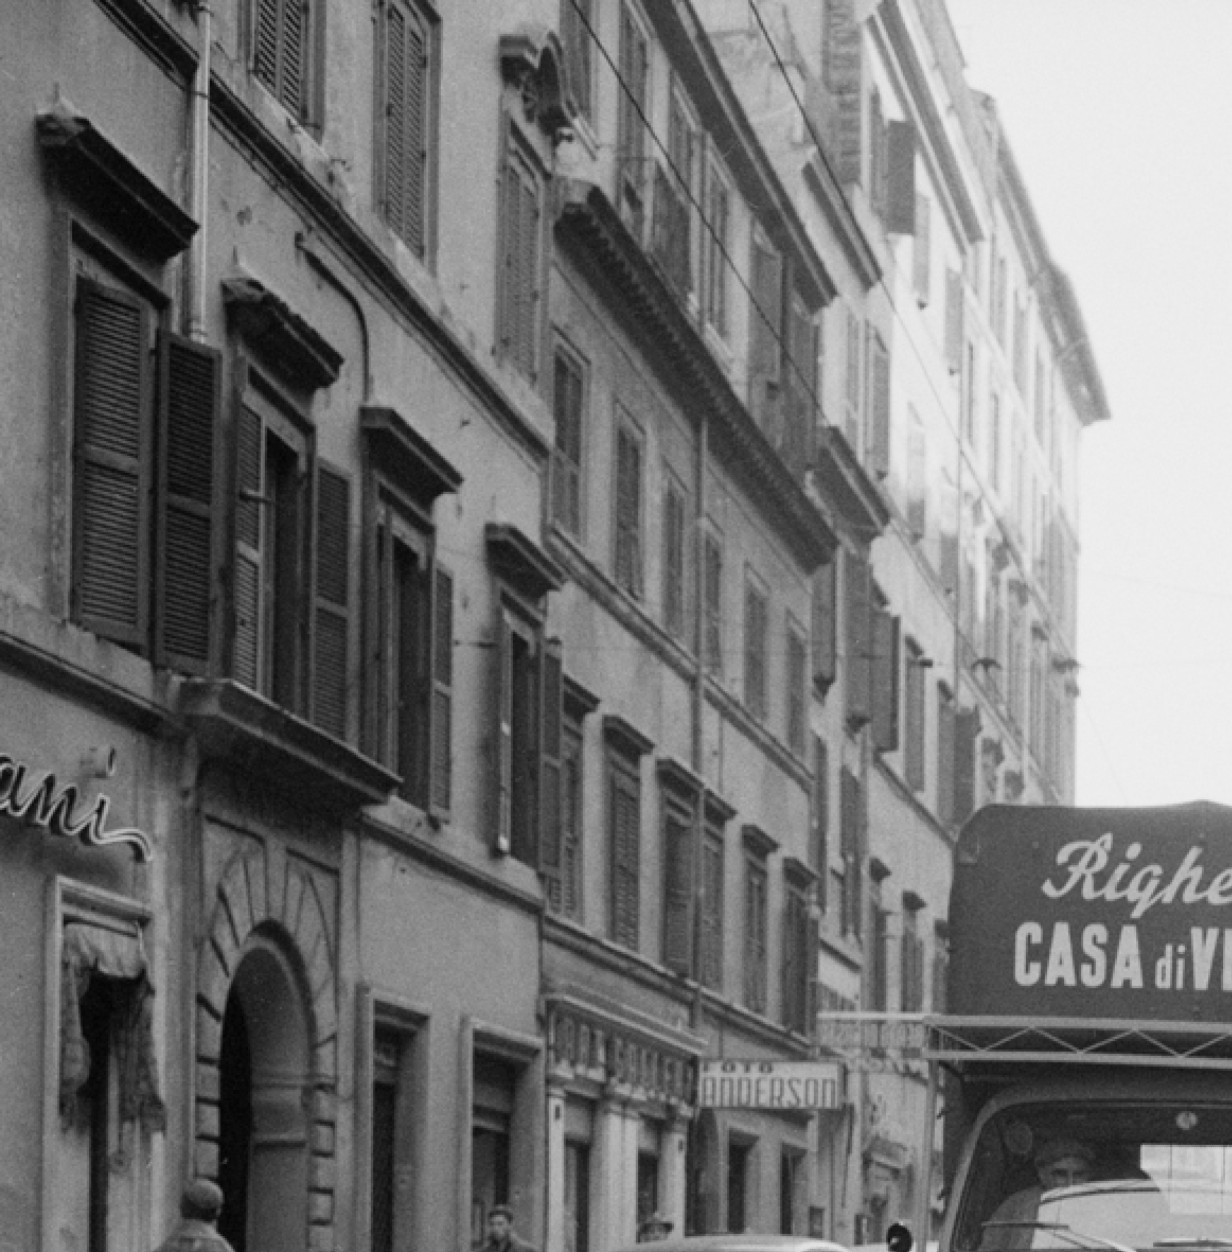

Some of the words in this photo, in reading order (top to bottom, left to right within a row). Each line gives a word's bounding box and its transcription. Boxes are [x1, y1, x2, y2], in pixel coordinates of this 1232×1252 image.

[1013, 921, 1144, 990] CASA
[1155, 944, 1185, 991] di
[702, 1077, 837, 1109] ANDERSON
